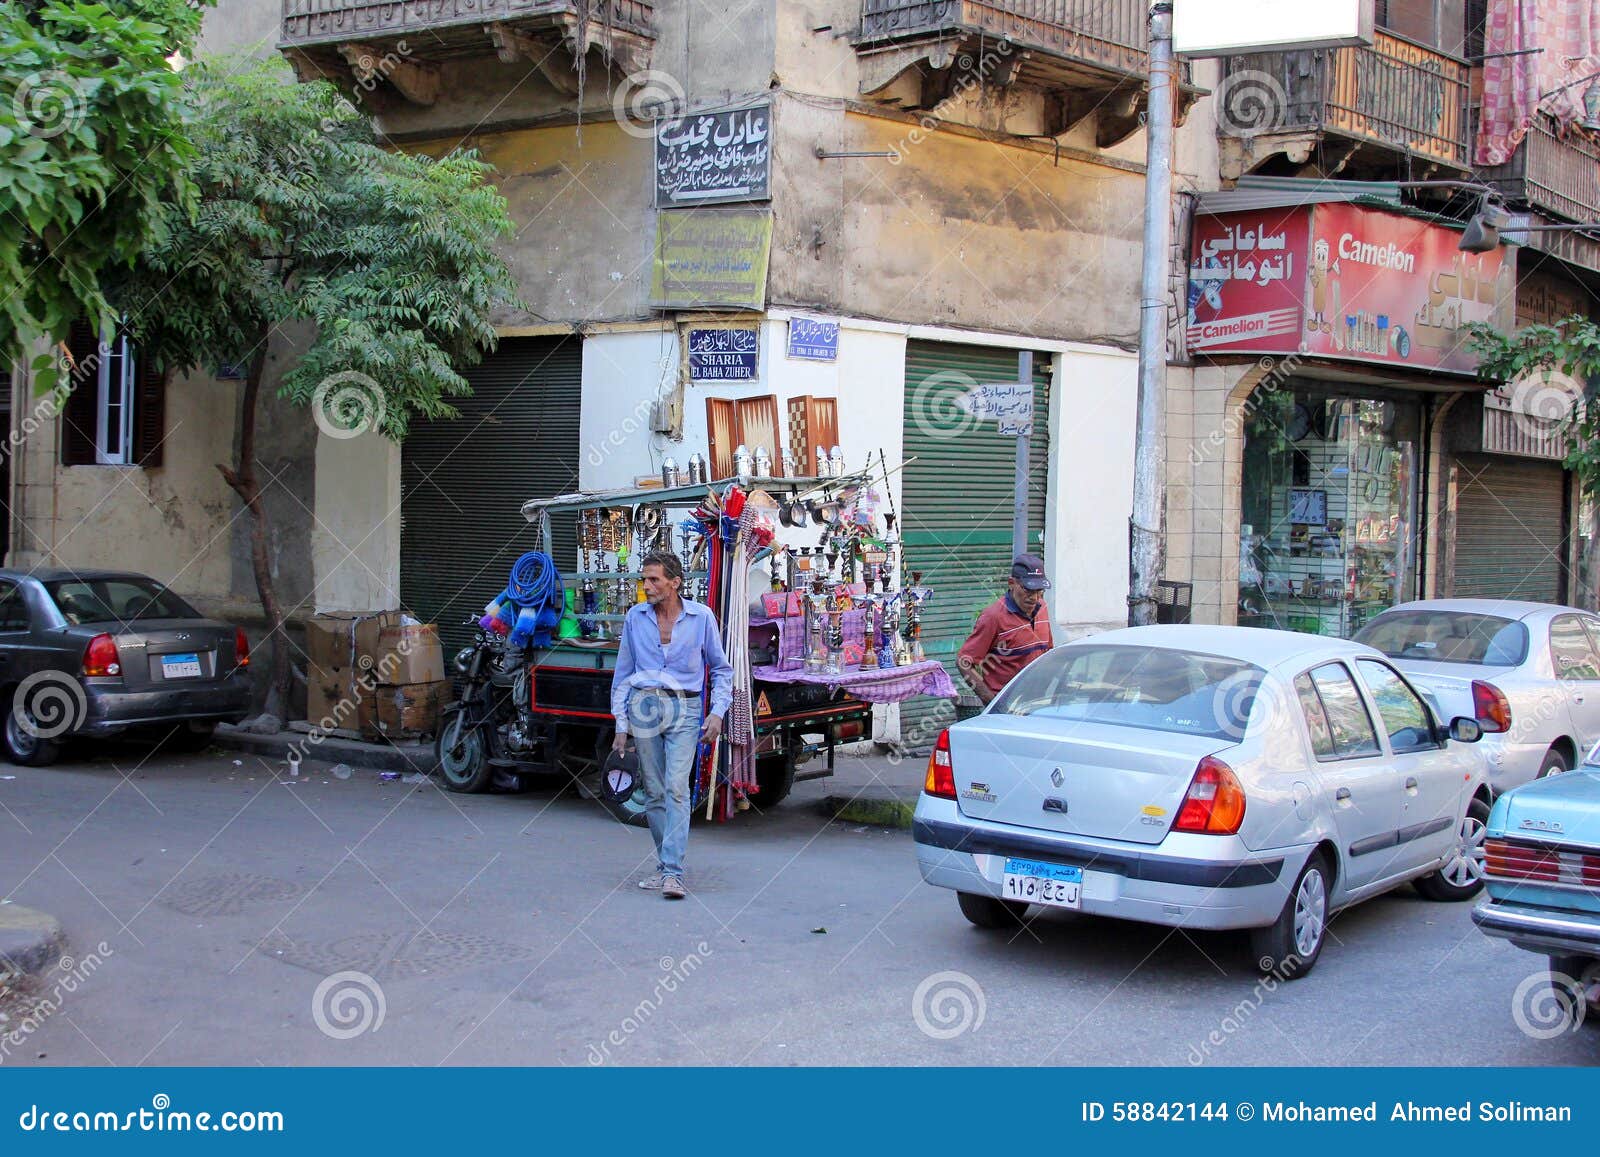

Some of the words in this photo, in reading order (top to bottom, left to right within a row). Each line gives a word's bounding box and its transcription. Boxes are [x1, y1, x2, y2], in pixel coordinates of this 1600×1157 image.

[714, 110, 768, 148] عادل
[1338, 233, 1415, 274] Camelion
[733, 329, 756, 352] شارع
[1202, 319, 1265, 340] Camelion
[701, 354, 743, 366] SHARIA
[691, 366, 701, 378] EL
[702, 366, 724, 378] BAHA
[725, 366, 752, 378] ZUHER
